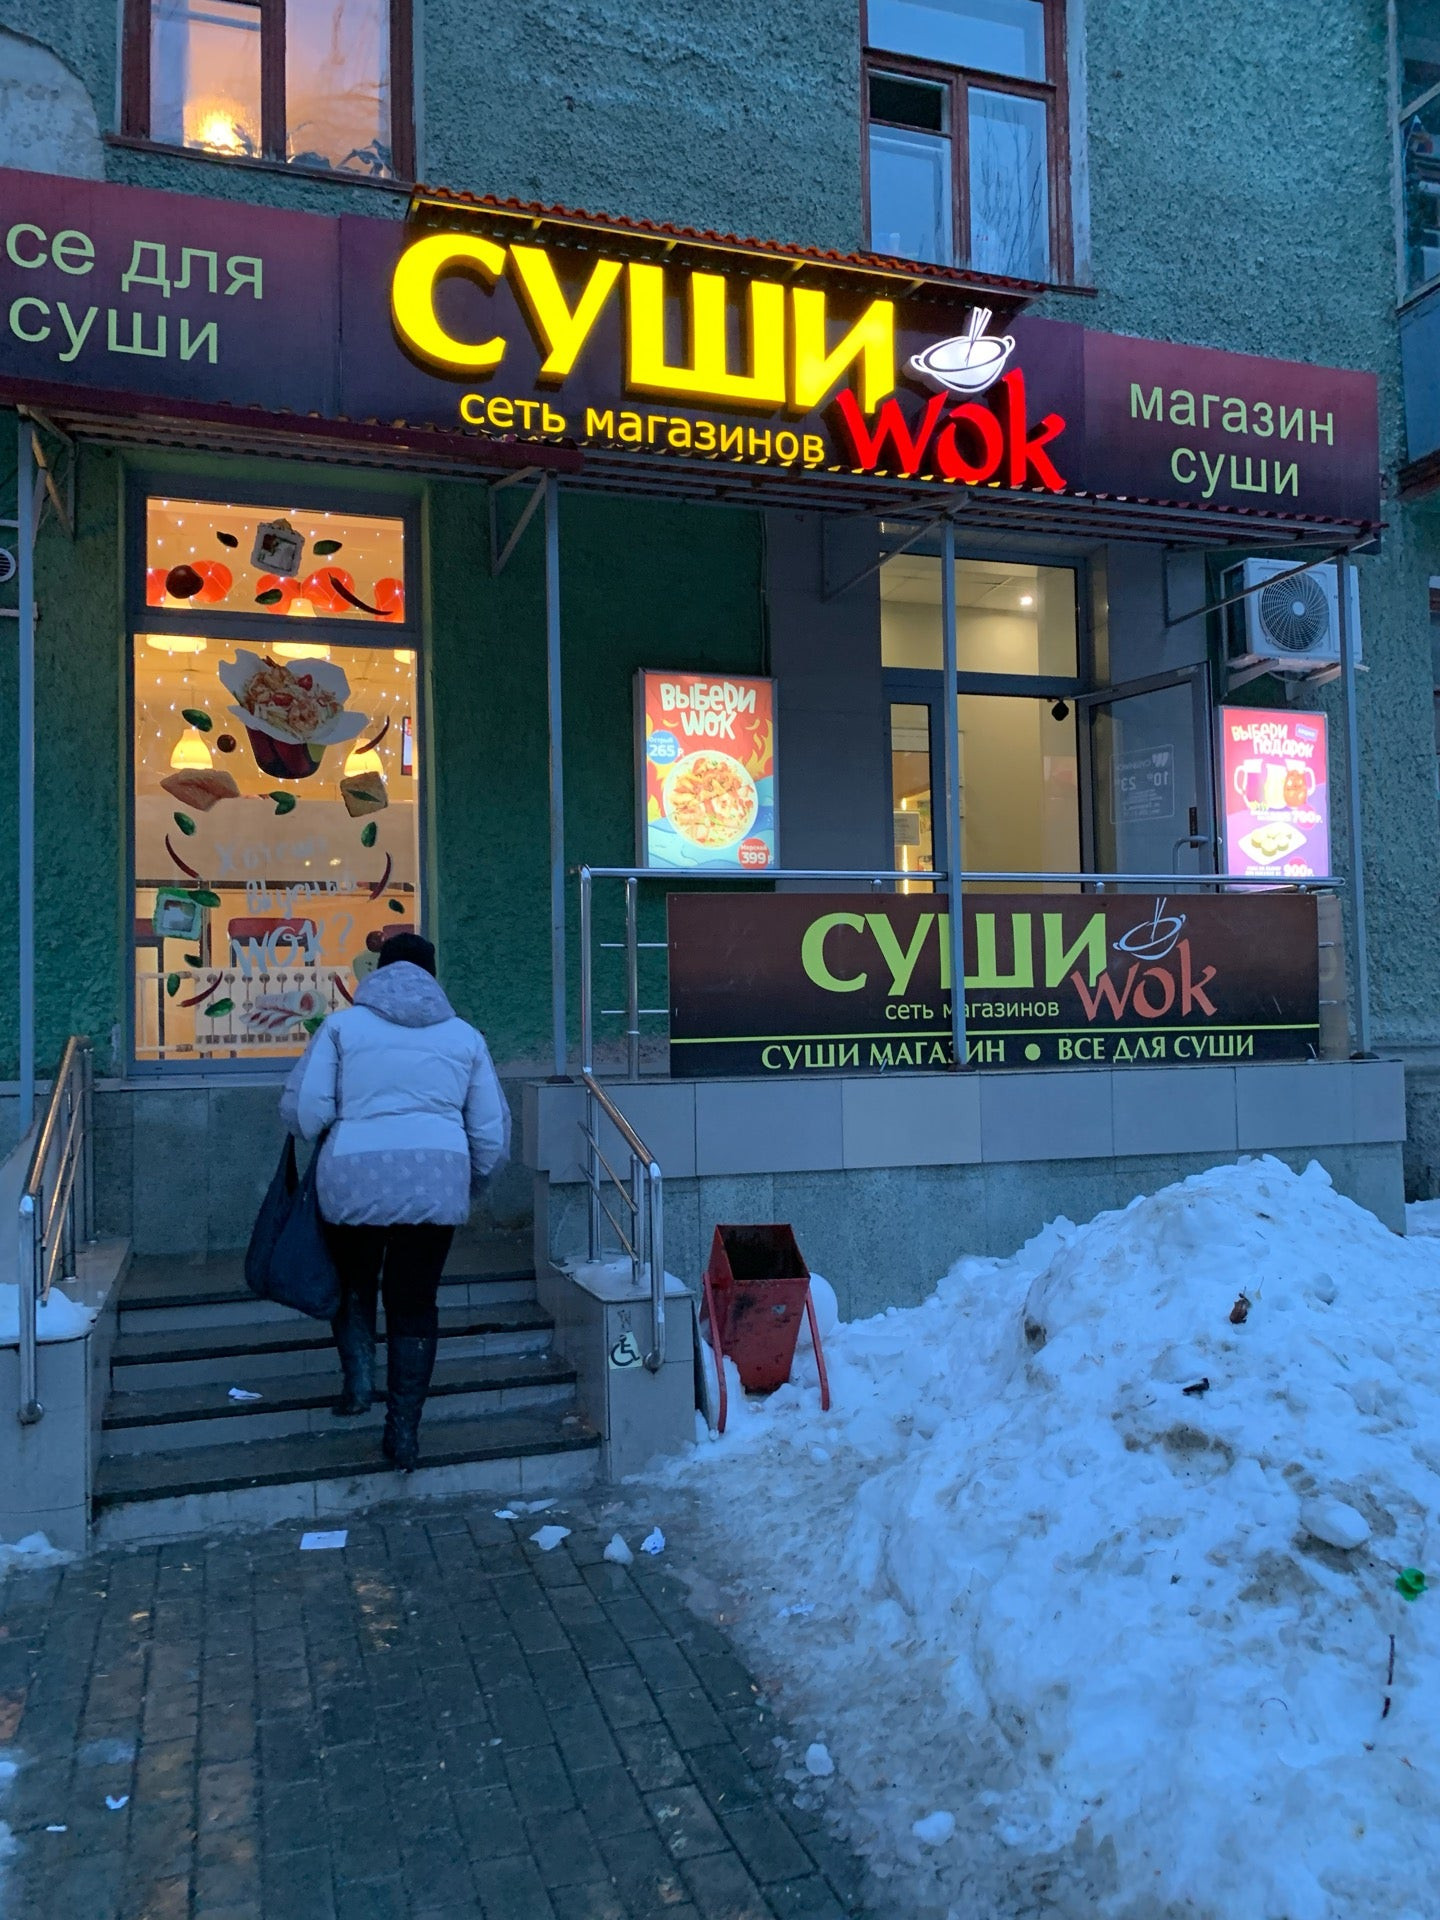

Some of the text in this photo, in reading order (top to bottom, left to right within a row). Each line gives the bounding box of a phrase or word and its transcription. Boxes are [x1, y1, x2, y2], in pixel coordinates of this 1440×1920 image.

[121, 240, 264, 300] для
[8, 295, 218, 364] суши
[391, 233, 895, 414] СУШИ
[459, 393, 825, 464] сеть магазинов
[1129, 383, 1334, 447] магазин
[1170, 447, 1299, 499] суши
[649, 744, 676, 757] 265
[741, 851, 767, 864] 399
[800, 912, 1107, 996] СУШИ
[885, 1003, 934, 1020] сеть
[761, 1043, 860, 1070] СУШИ
[1058, 1037, 1105, 1060] ВСЕ
[1112, 1036, 1166, 1064] ДЛЯ
[1173, 1034, 1254, 1059] СУШИ
